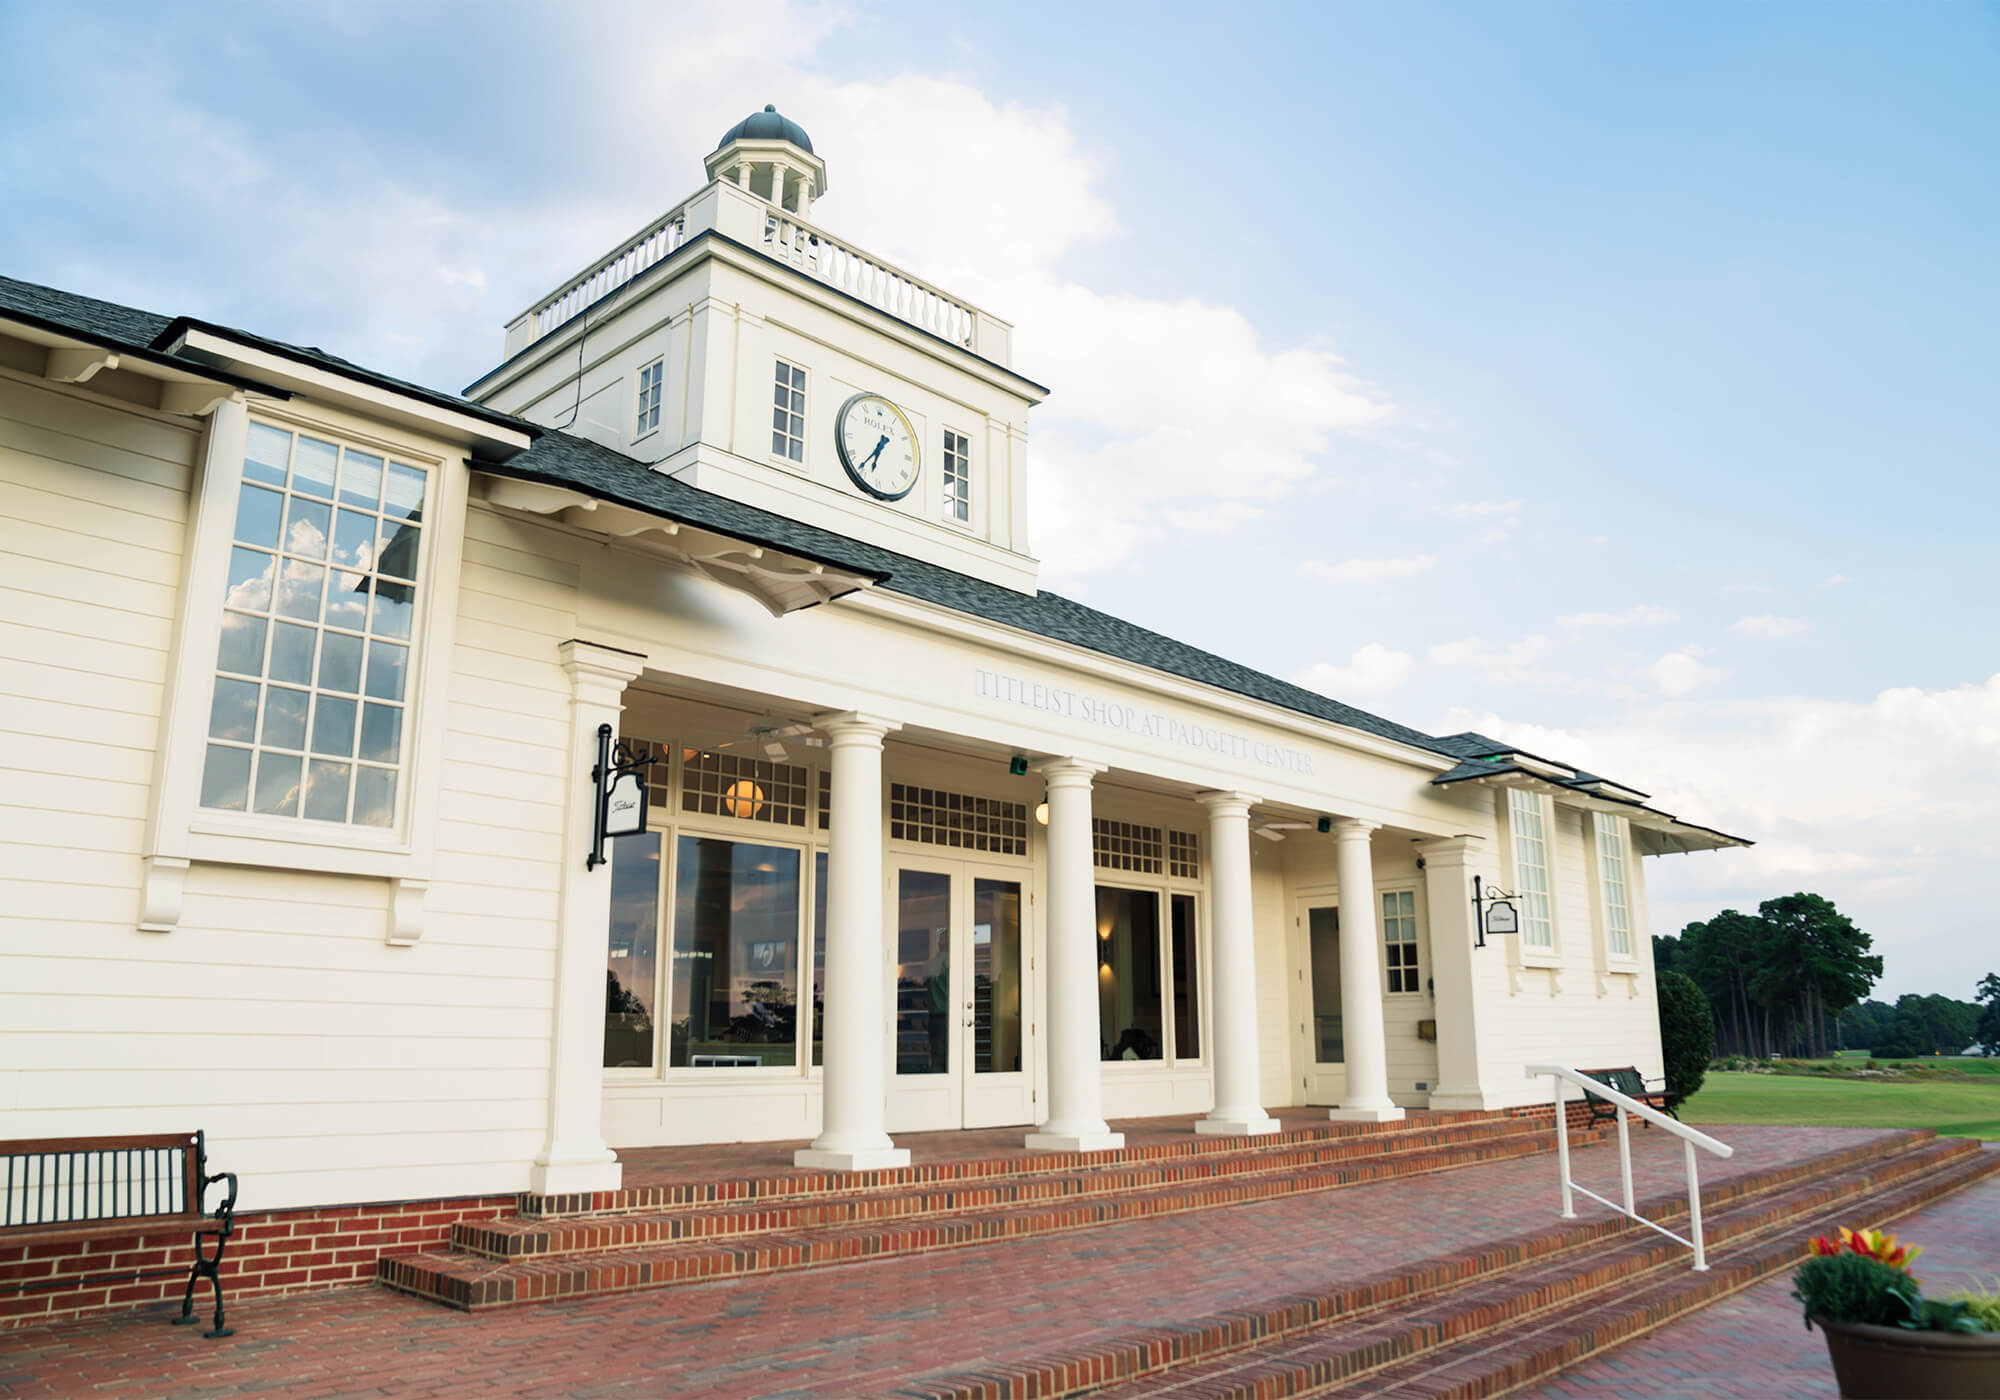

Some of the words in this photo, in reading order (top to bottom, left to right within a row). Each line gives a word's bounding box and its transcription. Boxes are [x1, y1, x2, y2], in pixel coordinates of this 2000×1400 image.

[864, 417, 895, 436] ROLEX
[976, 669, 1077, 716] TITLEIST
[1081, 696, 1135, 729] SHOP
[1142, 712, 1165, 737] AT
[1168, 719, 1249, 760] PADGETT
[1253, 741, 1315, 777] CENTER
